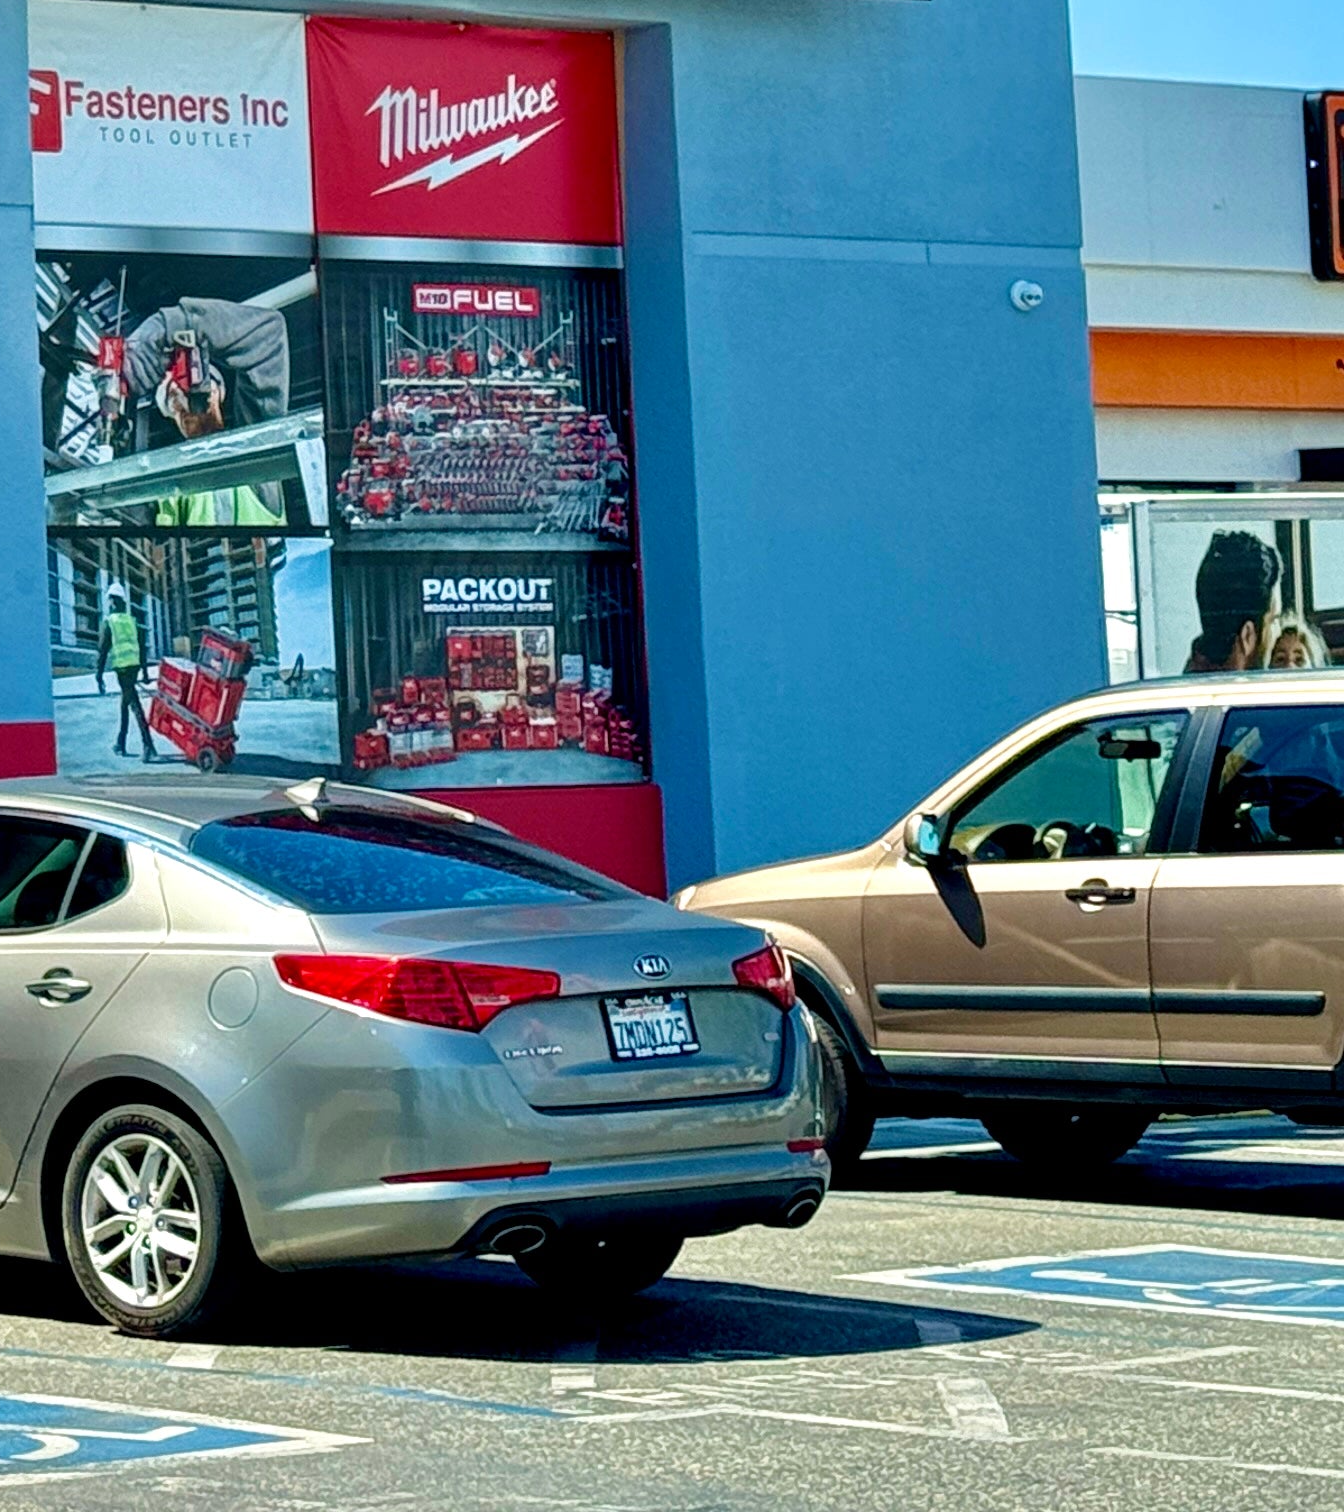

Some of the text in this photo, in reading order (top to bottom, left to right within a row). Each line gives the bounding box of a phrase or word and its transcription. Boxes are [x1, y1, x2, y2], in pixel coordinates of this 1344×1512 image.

[64, 80, 230, 125] Fasteners
[240, 93, 289, 128] Inc
[365, 74, 560, 168] Milwaukee
[100, 126, 253, 148] TOOL OUTLET
[453, 289, 534, 311] FUEL
[422, 577, 554, 601] PACKOUT
[640, 957, 670, 974] KIA
